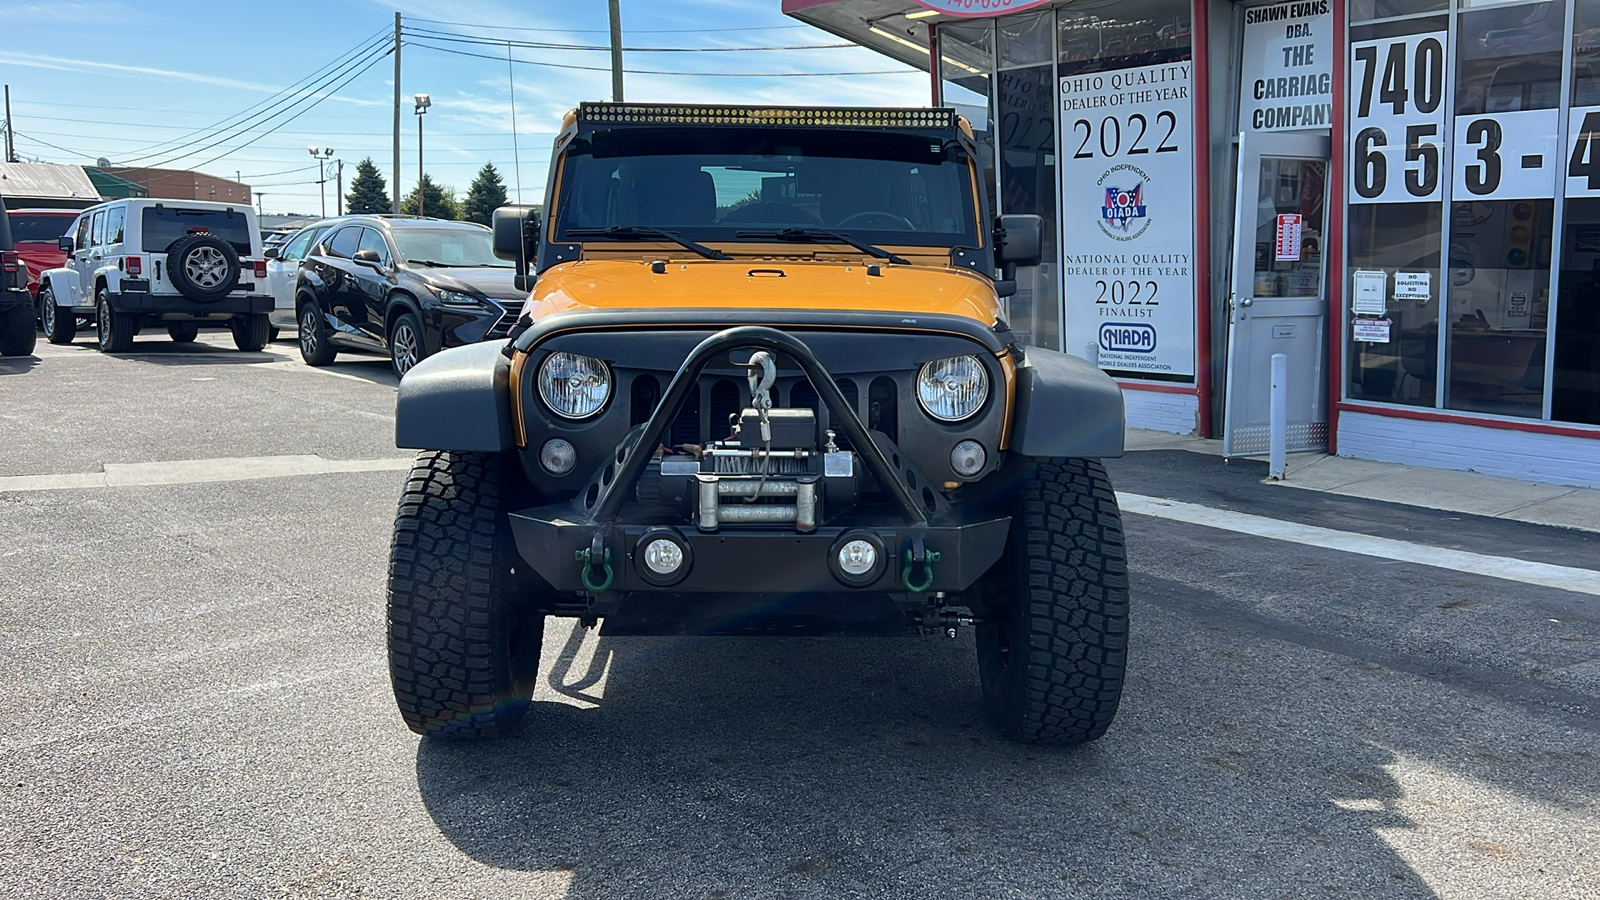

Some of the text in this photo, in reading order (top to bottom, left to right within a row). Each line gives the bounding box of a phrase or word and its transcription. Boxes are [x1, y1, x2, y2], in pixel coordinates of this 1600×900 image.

[1246, 0, 1330, 24] SHAWN EVANS.
[1286, 22, 1313, 39] DBA.
[1282, 44, 1315, 68] THE
[1061, 76, 1104, 94] OHIO
[1111, 65, 1190, 90] QUALITY
[1253, 72, 1333, 100] CARRIAG
[1354, 37, 1444, 118] 740
[1063, 95, 1108, 111] DEALER
[1109, 93, 1126, 106] OF
[1127, 89, 1153, 104] THE
[1154, 86, 1188, 100] YEAR
[1073, 110, 1179, 159] 2022
[1096, 163, 1152, 186] OHIO INDEPENDENT
[1106, 206, 1139, 218] OIADA
[1066, 254, 1190, 266] NATIONAL QUALITY
[1067, 267, 1188, 276] DEALER OF THE YEAR
[1095, 280, 1160, 306] 2022
[1099, 307, 1154, 318] FINALIST
[1103, 328, 1151, 347] NIADA
[1124, 354, 1157, 362] INDEPENDENT
